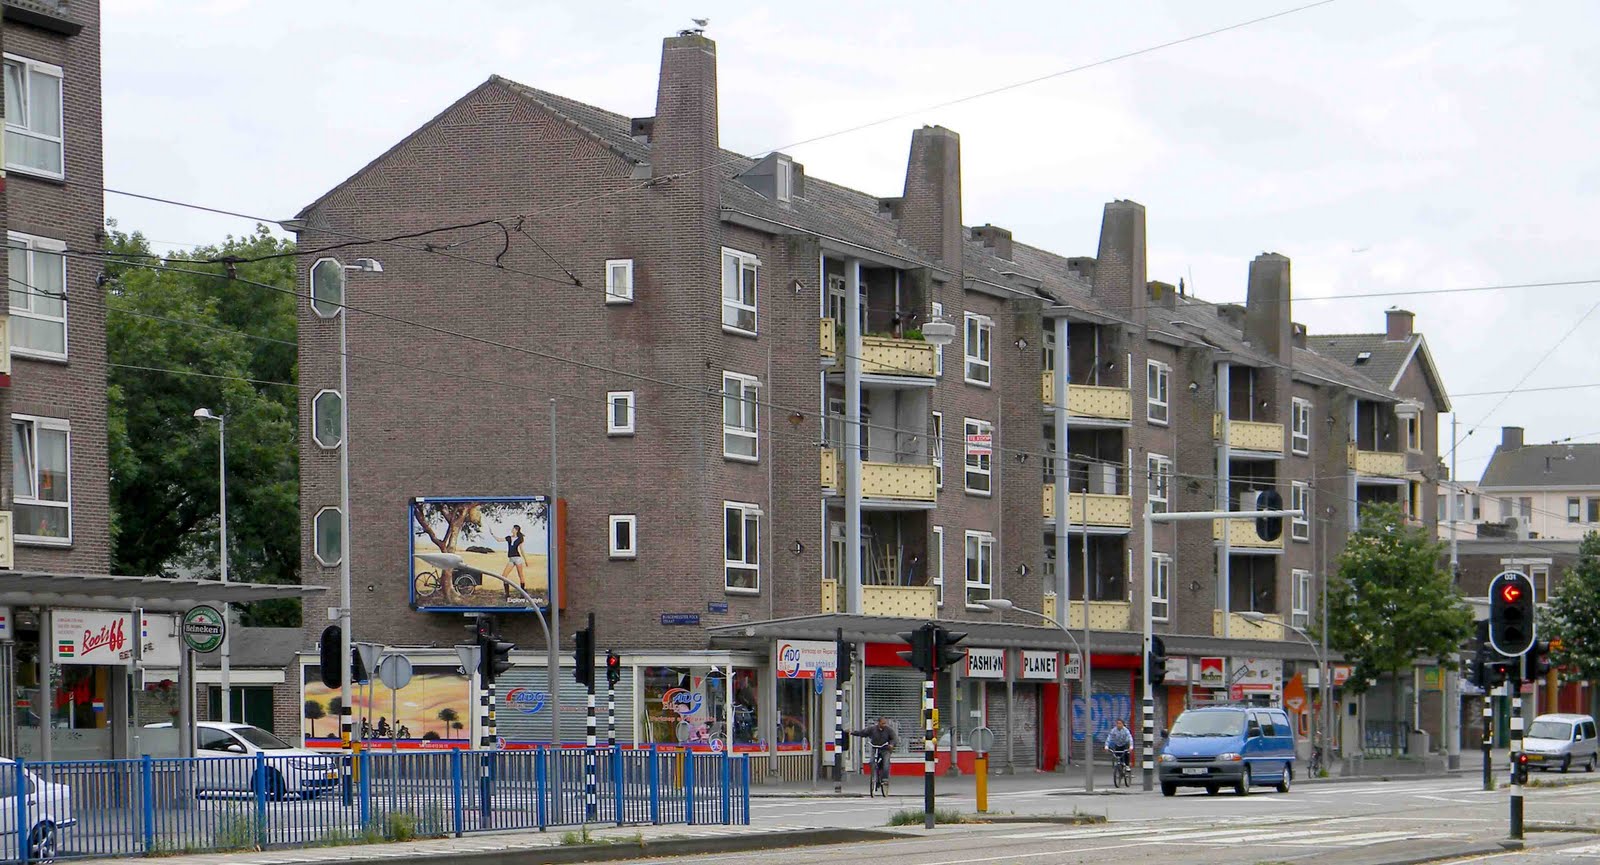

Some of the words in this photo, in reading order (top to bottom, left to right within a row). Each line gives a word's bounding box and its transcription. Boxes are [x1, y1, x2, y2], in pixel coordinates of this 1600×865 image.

[186, 624, 219, 634] Heineken
[784, 649, 800, 661] ADO
[1024, 657, 1056, 673] PLANET
[516, 692, 544, 702] ADO
[673, 692, 702, 703] ADO
